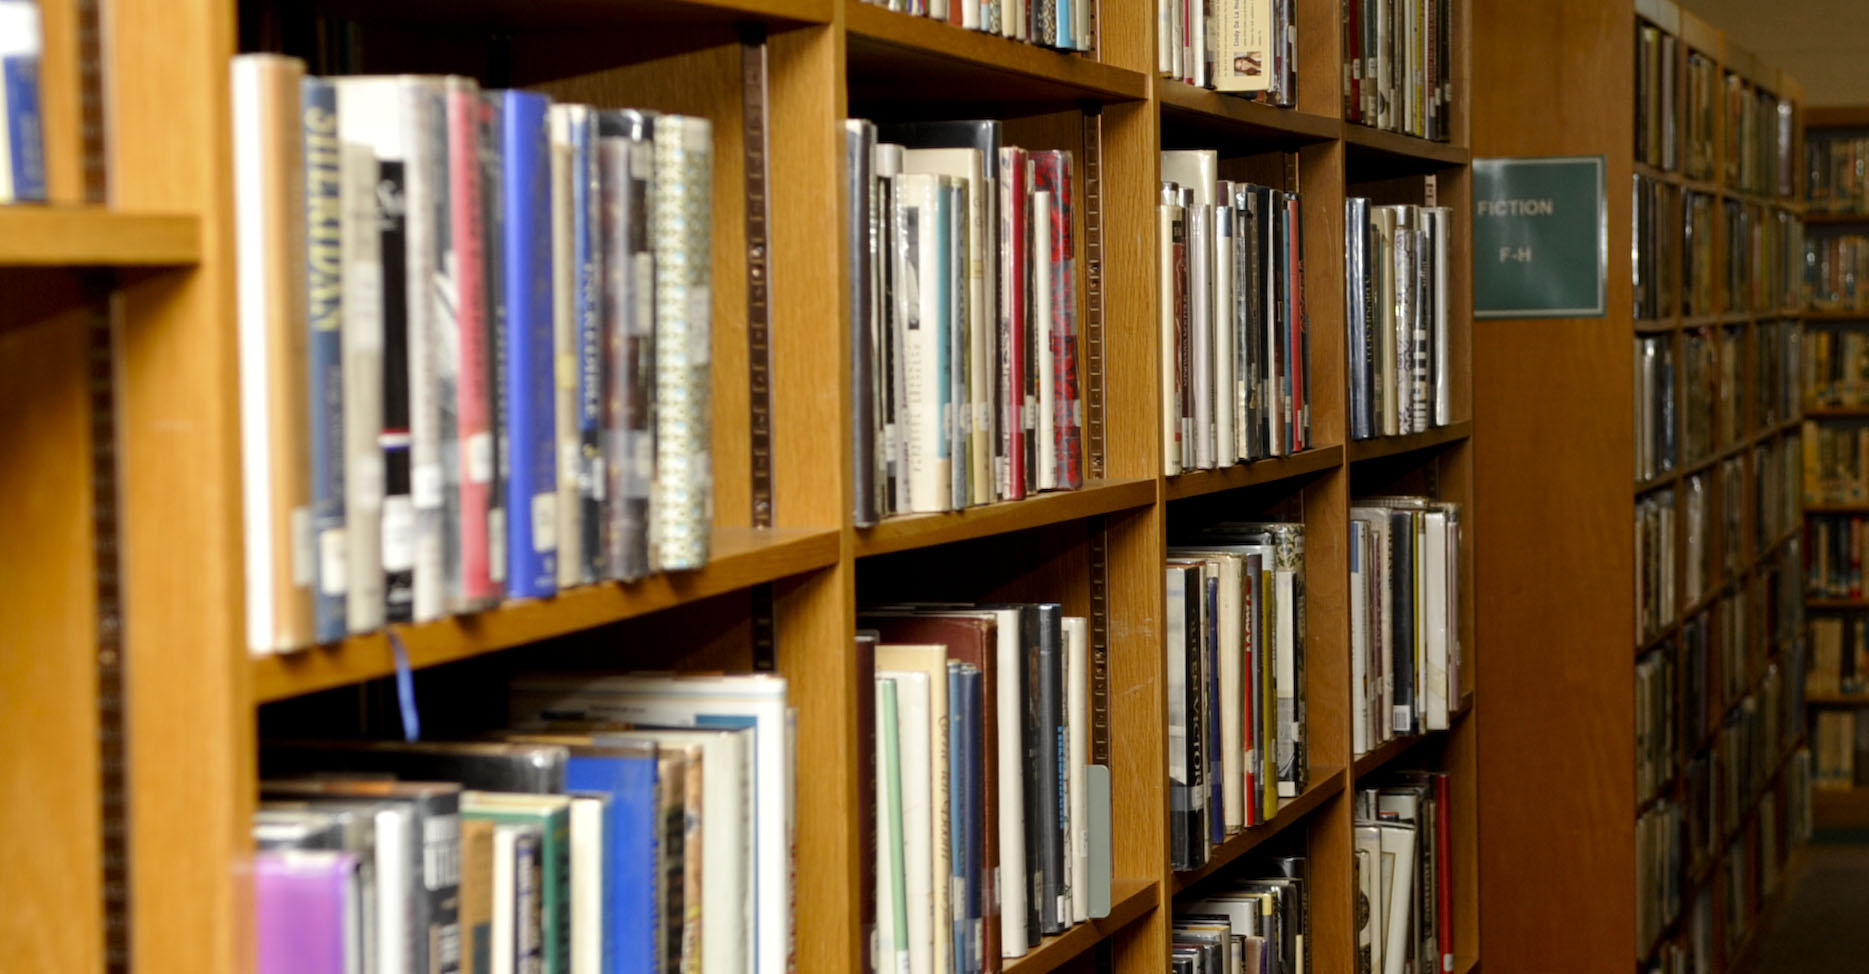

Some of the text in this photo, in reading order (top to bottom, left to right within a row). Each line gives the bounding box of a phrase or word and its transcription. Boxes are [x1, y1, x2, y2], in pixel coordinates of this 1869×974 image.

[1477, 199, 1555, 217] FICTION
[1499, 246, 1533, 264] F-H
[1190, 607, 1202, 809] QUEEN VICTOR
